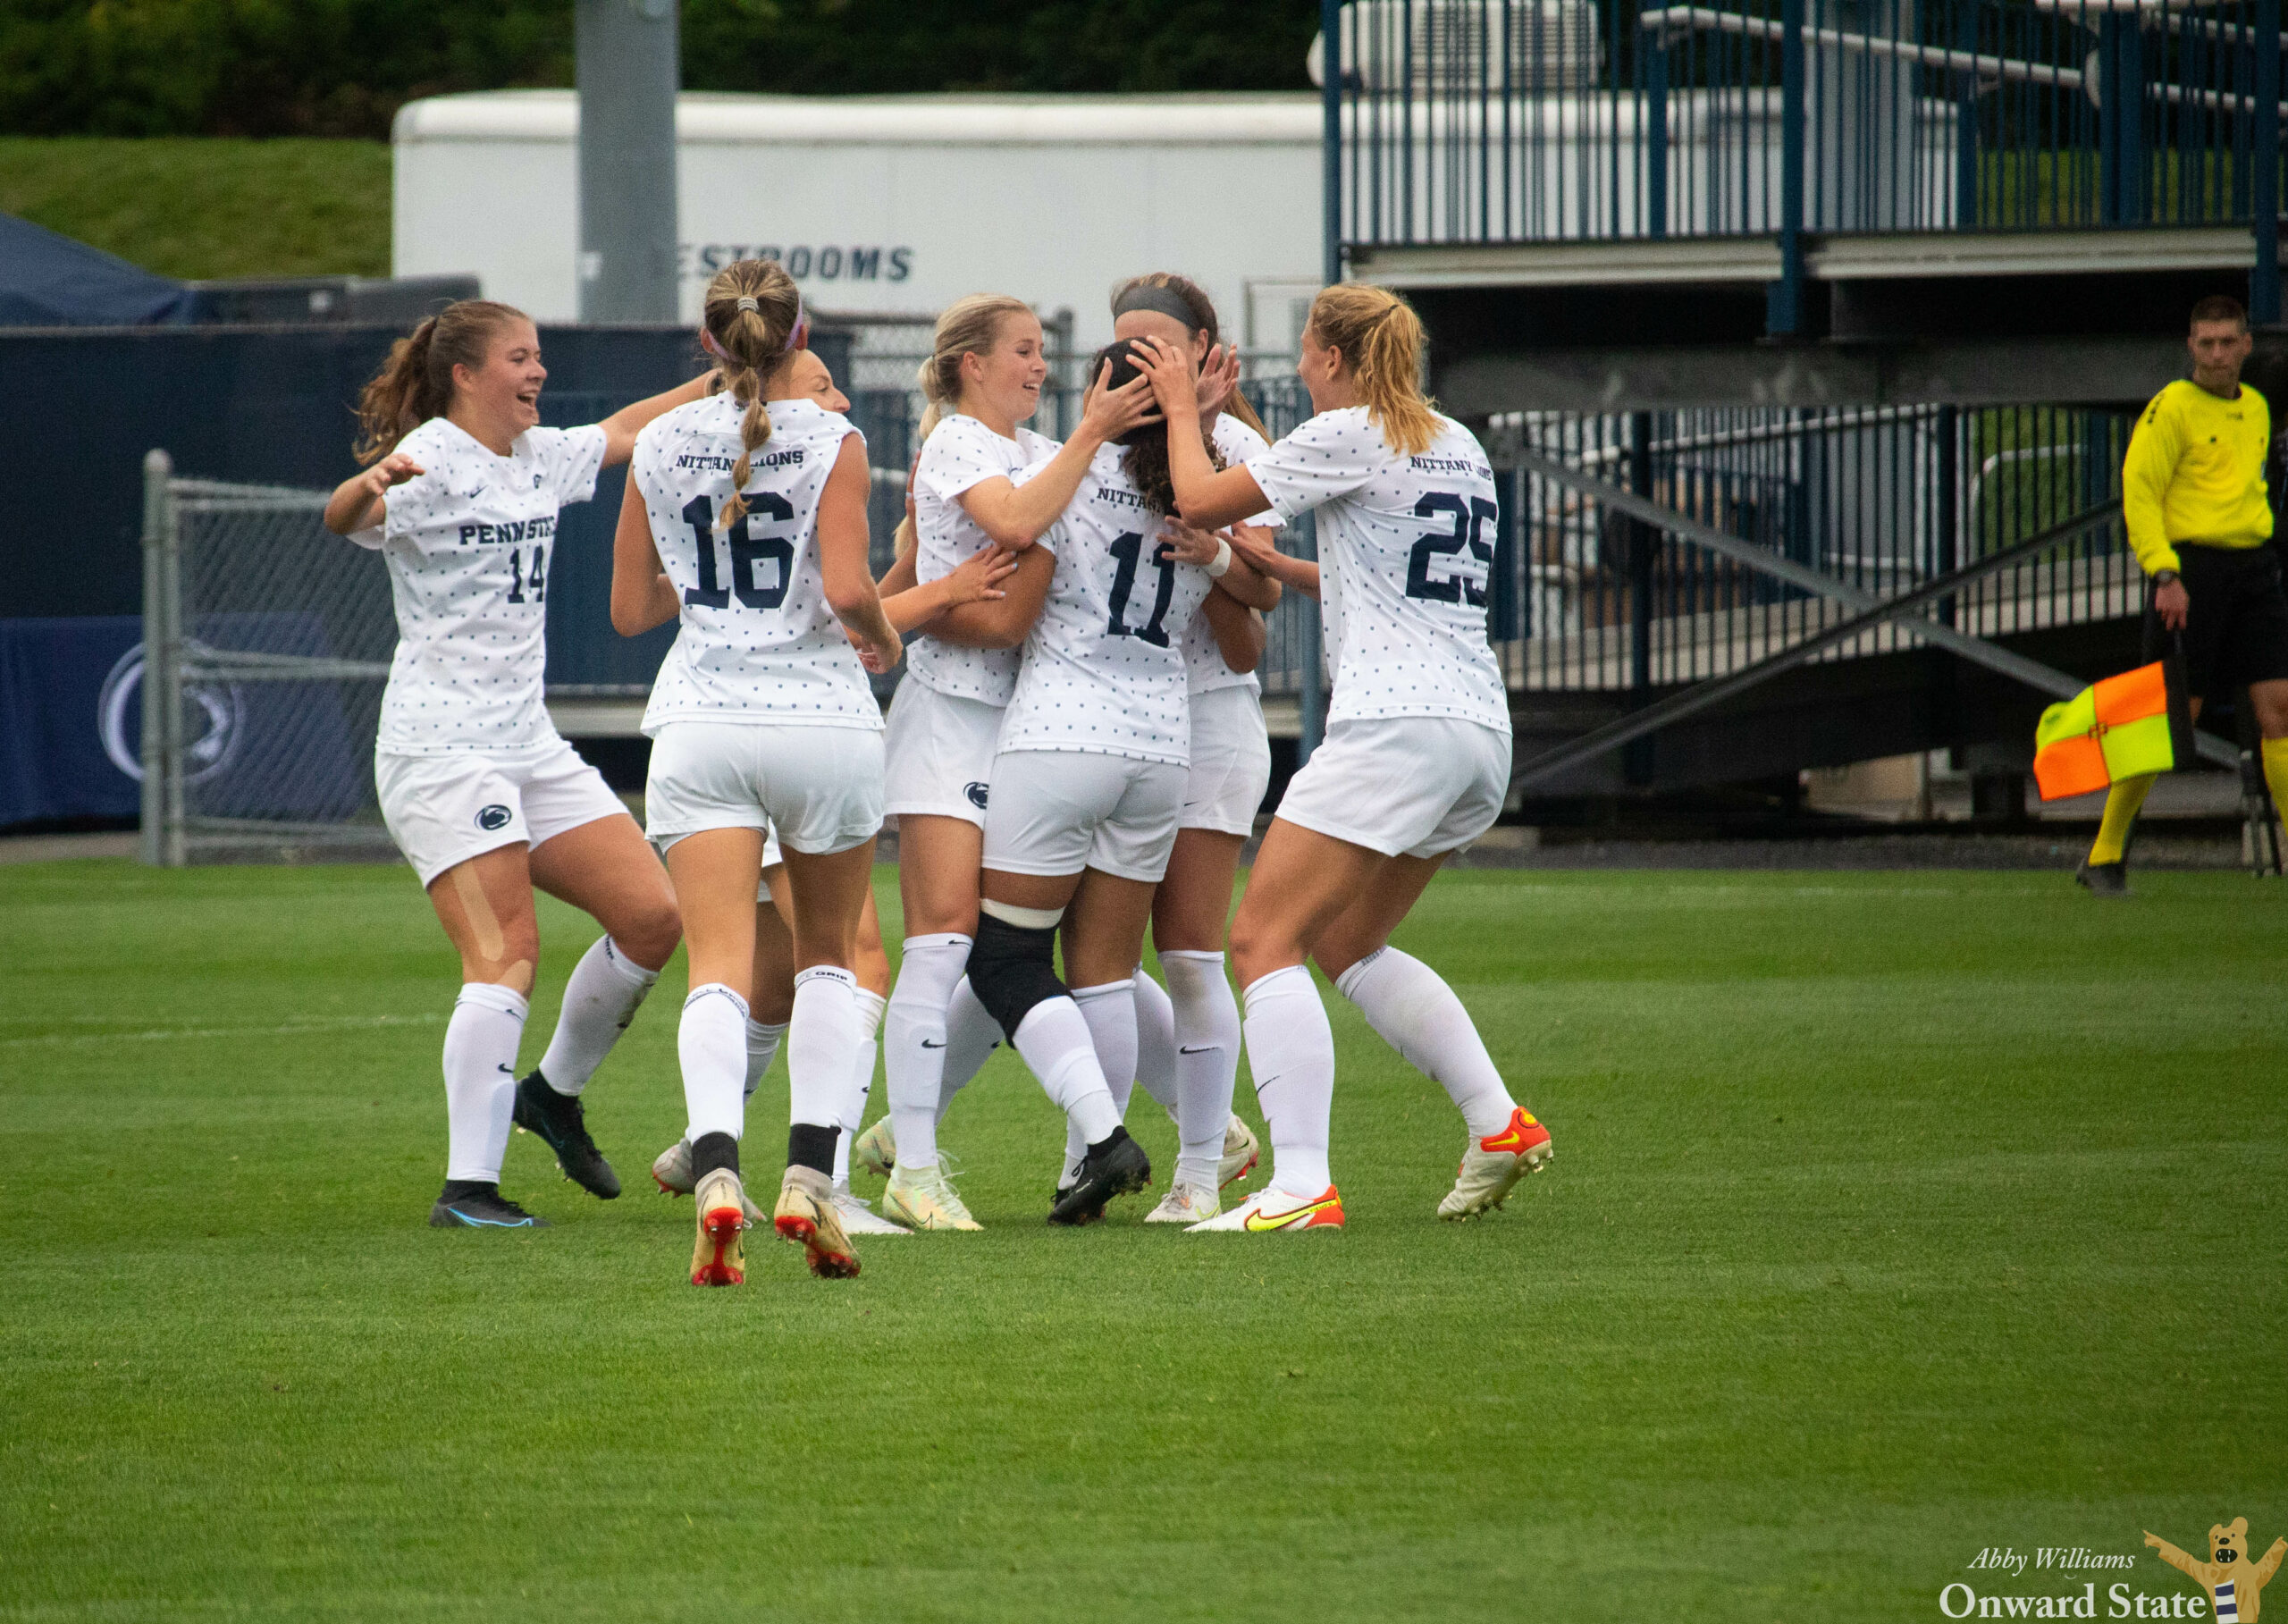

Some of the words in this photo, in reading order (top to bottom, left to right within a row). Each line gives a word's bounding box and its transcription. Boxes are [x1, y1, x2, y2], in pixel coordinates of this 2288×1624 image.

[676, 454, 736, 471] NITTAN
[1410, 456, 1473, 472] NITTANY
[1096, 487, 1160, 513] NITTA
[458, 521, 526, 545] PENN
[682, 492, 795, 609] 16
[1405, 492, 1498, 609] 25
[507, 543, 544, 604] 14
[1106, 531, 1176, 649] 11
